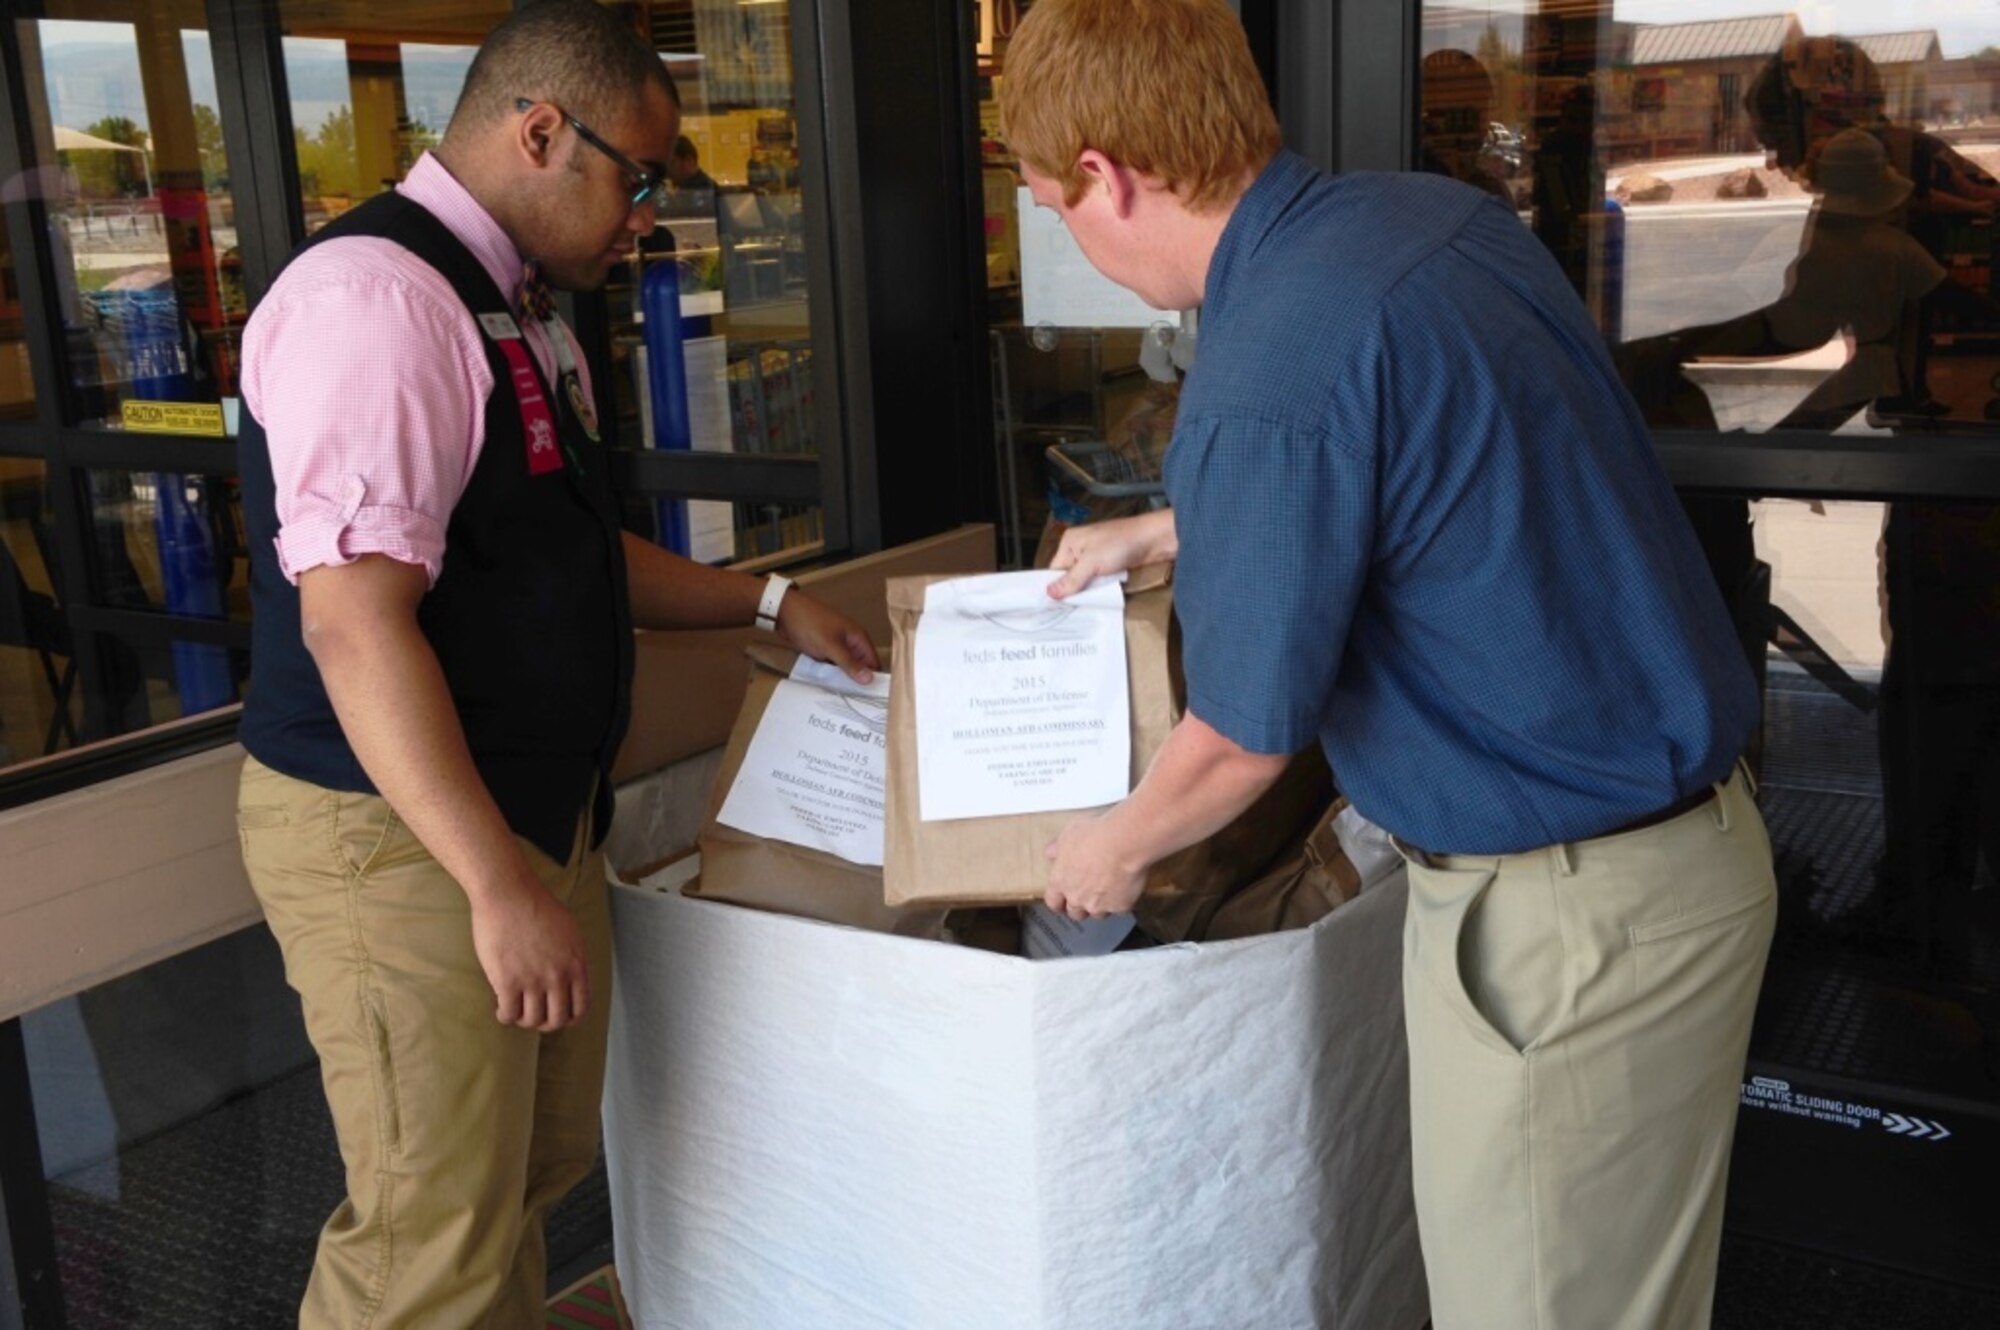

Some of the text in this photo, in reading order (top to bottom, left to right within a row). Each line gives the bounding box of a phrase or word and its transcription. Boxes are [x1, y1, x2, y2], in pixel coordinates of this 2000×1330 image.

[124, 405, 163, 420] CAUTION
[962, 641, 1098, 664] feds feed families
[1012, 674, 1046, 690] 2015
[970, 694, 1031, 710] Department
[1046, 690, 1089, 702] Defense
[808, 713, 837, 733] feds
[839, 723, 872, 743] feed
[796, 749, 850, 772] Department
[838, 748, 870, 766] 2015
[1740, 1083, 1793, 1103] TOMATIC
[1795, 1093, 1843, 1113] SLIDING
[1846, 1103, 1881, 1120] DOOR
[1741, 1095, 1861, 1129] lose without warning
